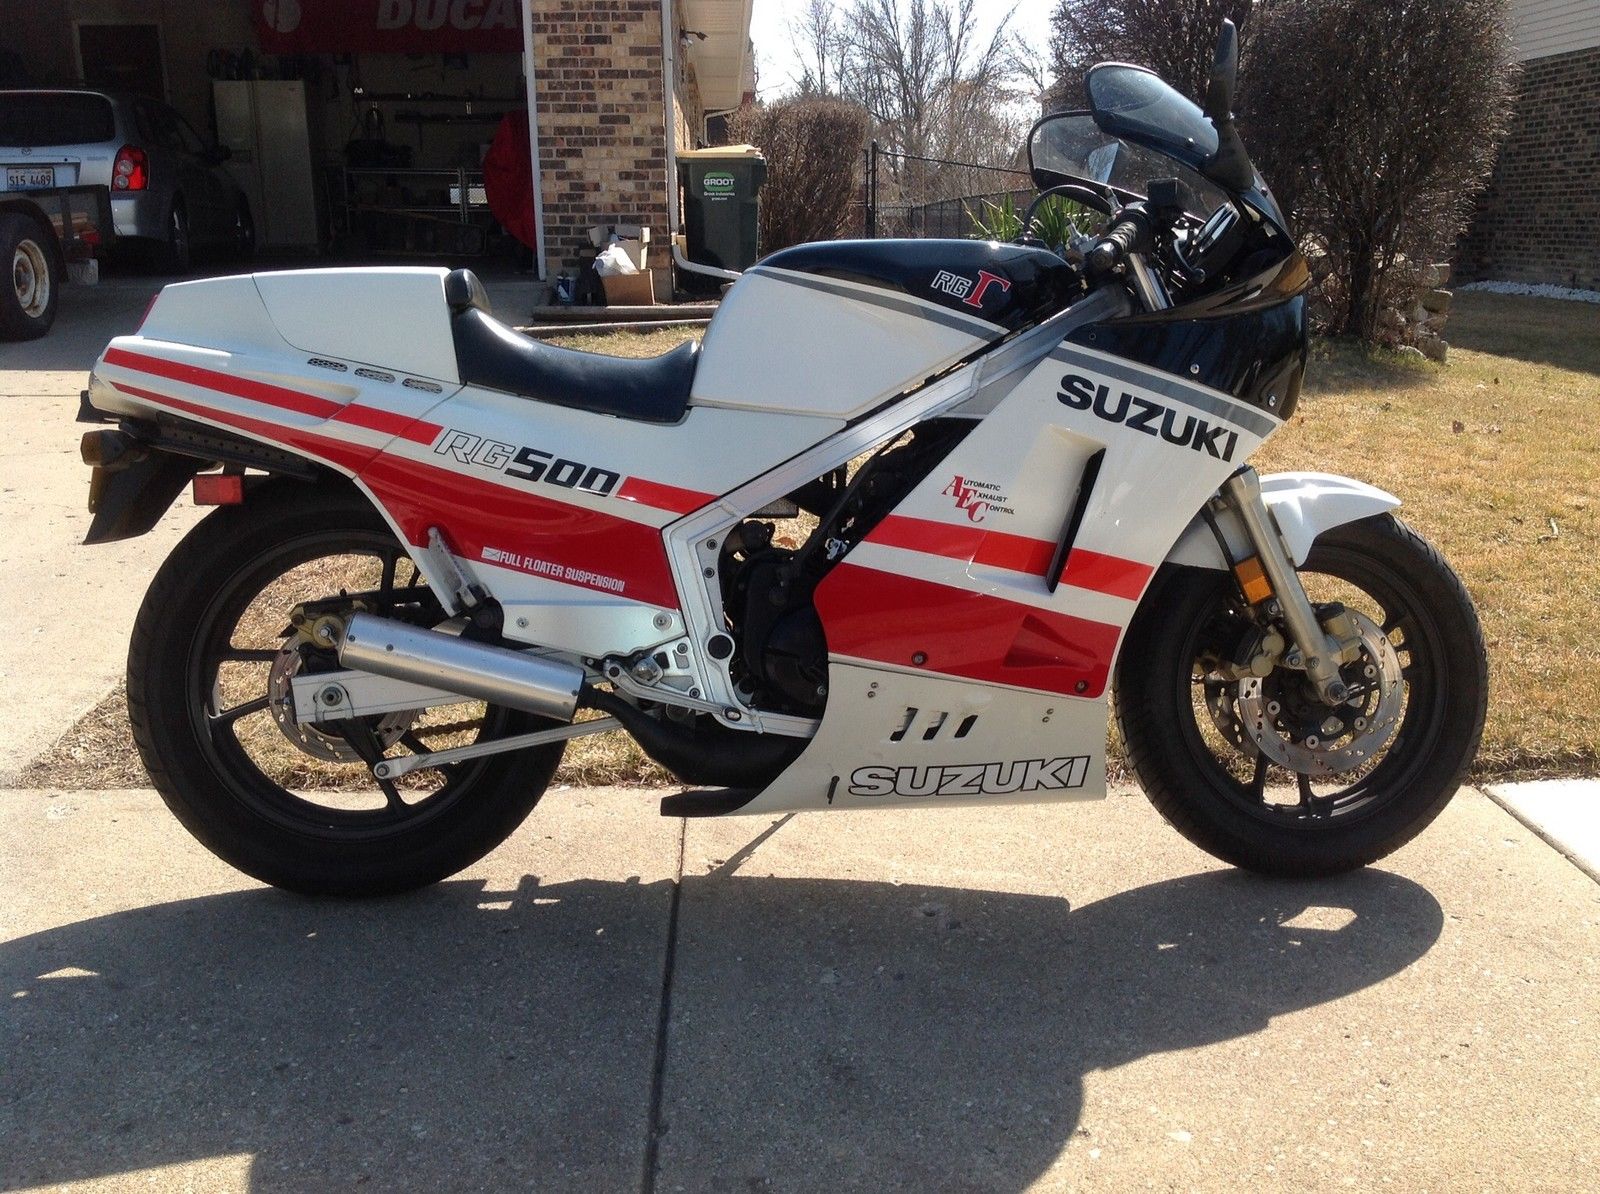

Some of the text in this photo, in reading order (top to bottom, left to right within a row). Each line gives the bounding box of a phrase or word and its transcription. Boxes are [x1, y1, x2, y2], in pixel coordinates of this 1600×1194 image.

[703, 178, 735, 186] GROOT
[1056, 374, 1239, 463] SUZUKI
[434, 428, 621, 497] RG500
[499, 551, 626, 593] FULL FLOATER SUSPENSION
[848, 755, 1091, 797] SUZUKI
